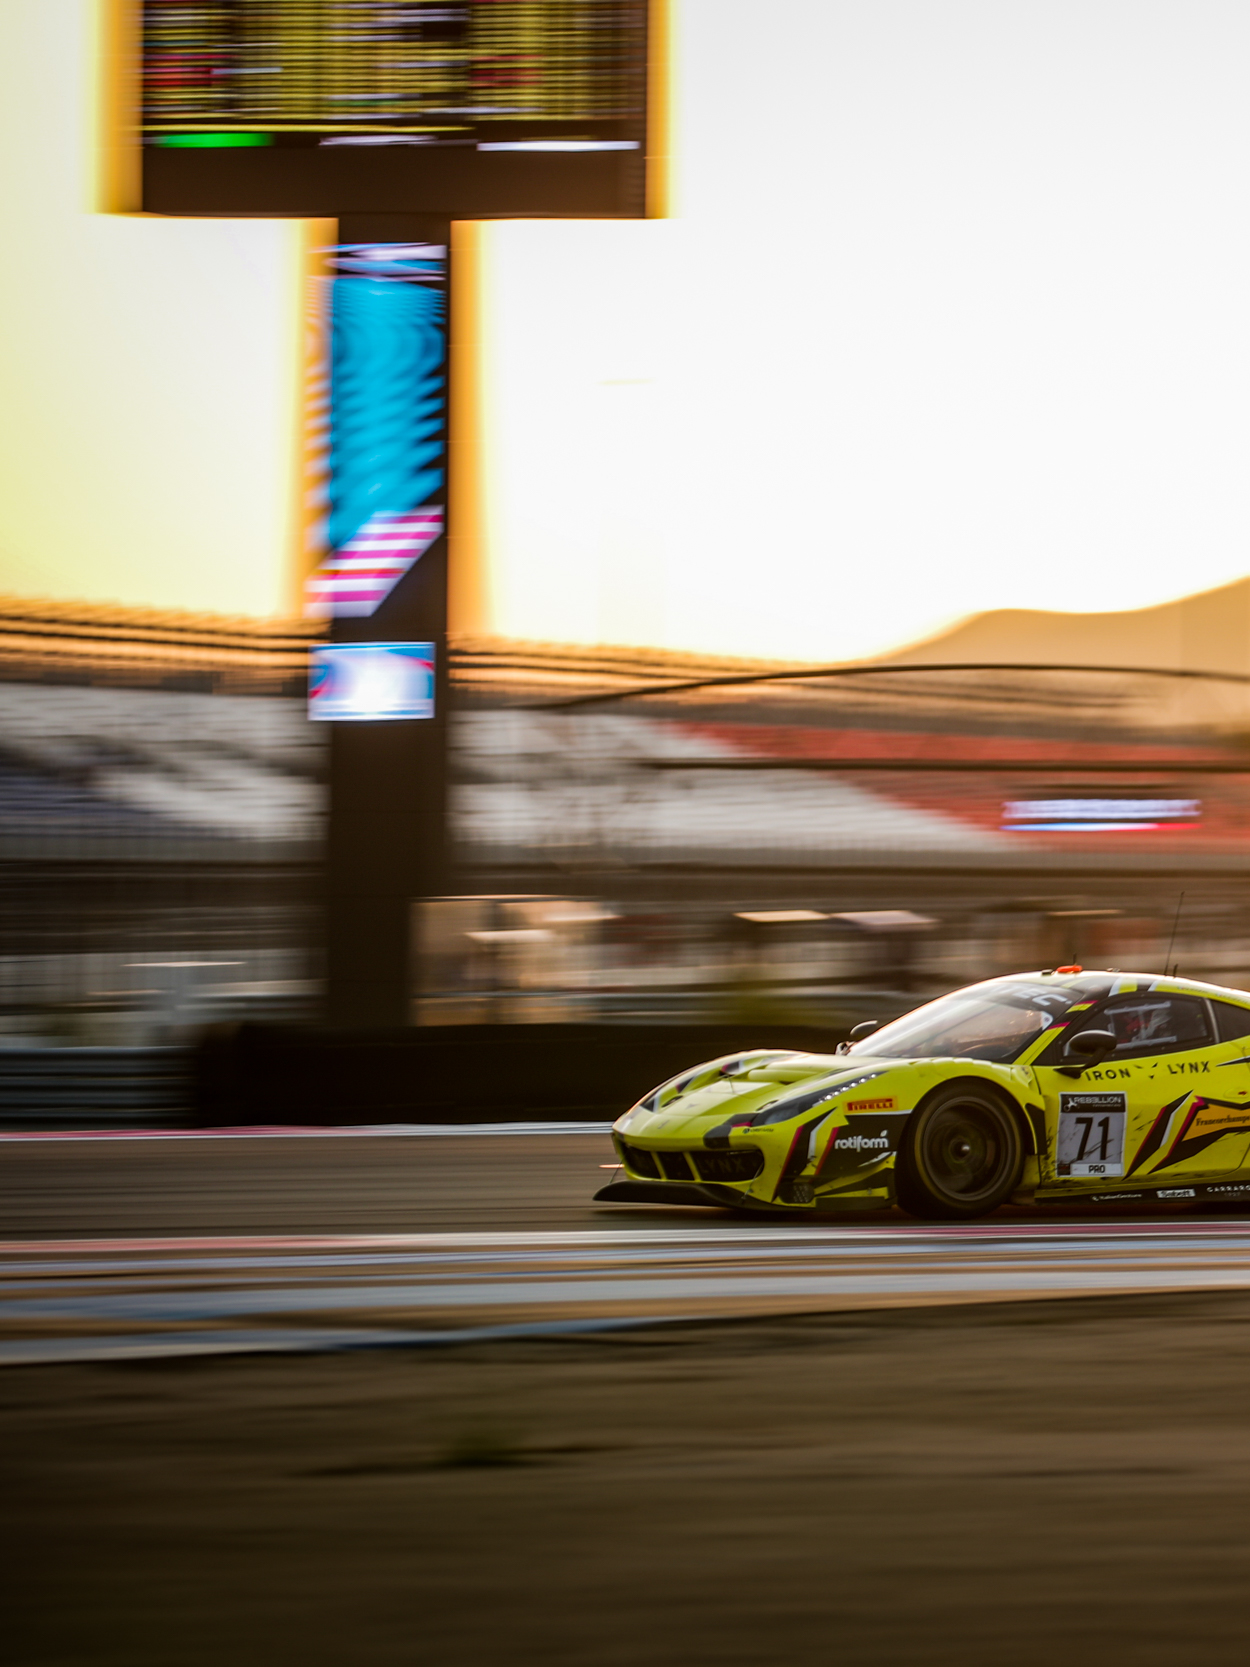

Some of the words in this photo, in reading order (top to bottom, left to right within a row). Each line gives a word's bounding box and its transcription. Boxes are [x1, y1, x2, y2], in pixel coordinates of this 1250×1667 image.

[1085, 1068, 1131, 1081] IRON
[1167, 1061, 1210, 1074] LYNX
[847, 1099, 893, 1111] PIRELLI
[834, 1134, 889, 1152] rotiform
[1075, 1116, 1110, 1161] 71
[1088, 1165, 1106, 1174] PRO
